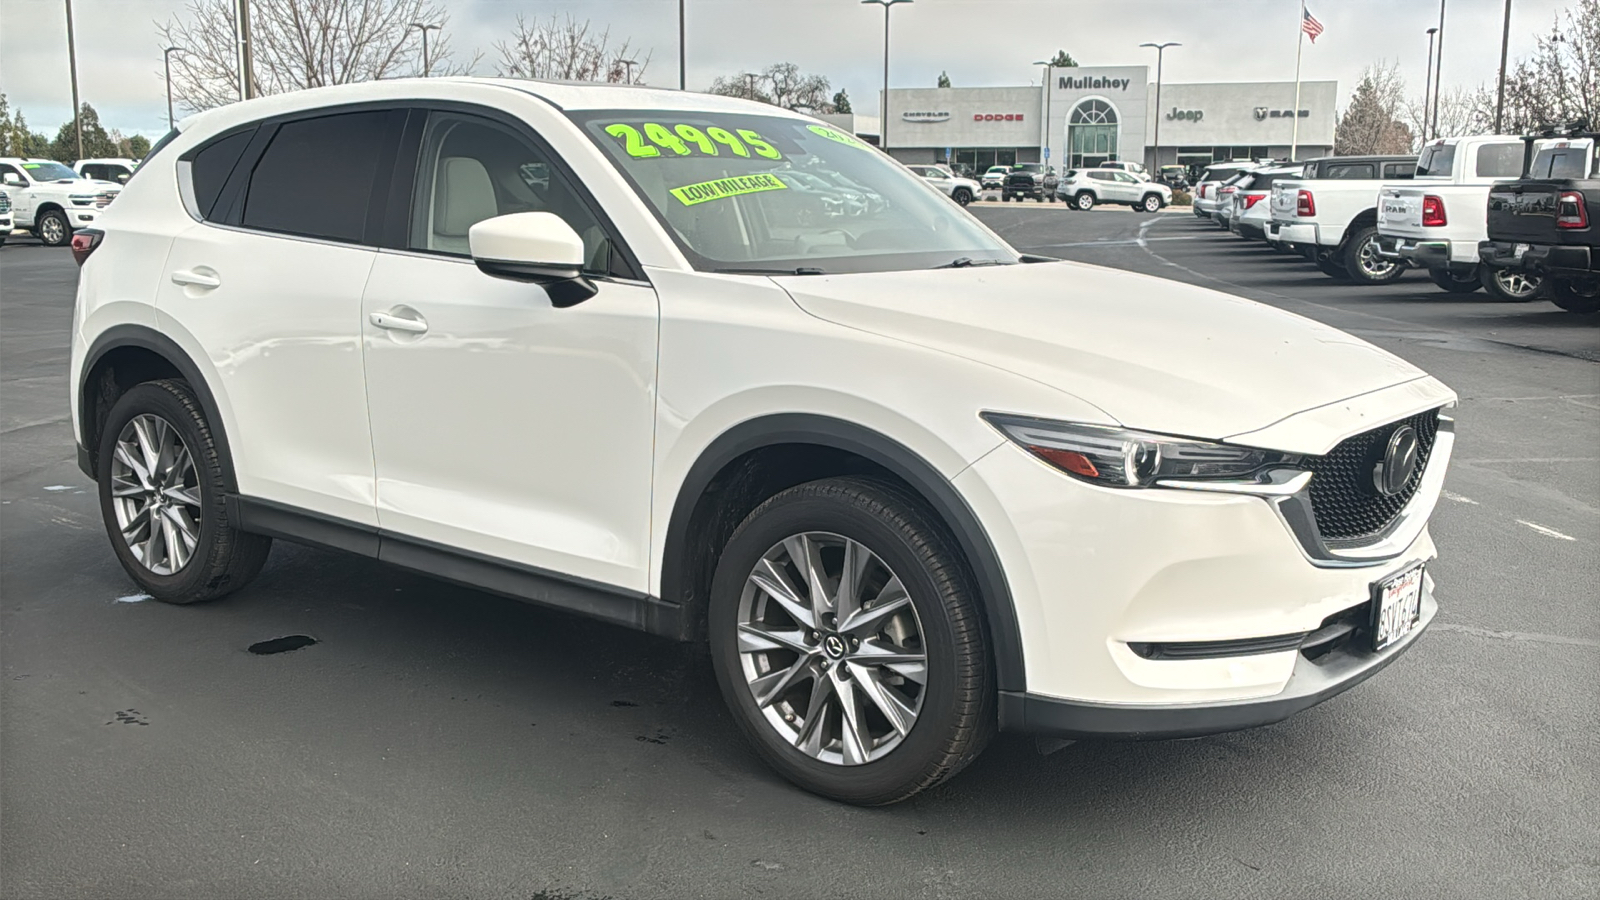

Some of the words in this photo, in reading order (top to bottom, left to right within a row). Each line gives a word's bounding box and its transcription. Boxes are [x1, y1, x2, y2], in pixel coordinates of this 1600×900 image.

[1058, 75, 1130, 92] Mullahey
[973, 113, 1024, 122] DODGE
[1166, 107, 1204, 122] Jeep
[605, 123, 782, 160] 24995
[680, 180, 717, 202] LOW
[714, 173, 777, 194] MILEAGE
[1385, 205, 1407, 214] RAM
